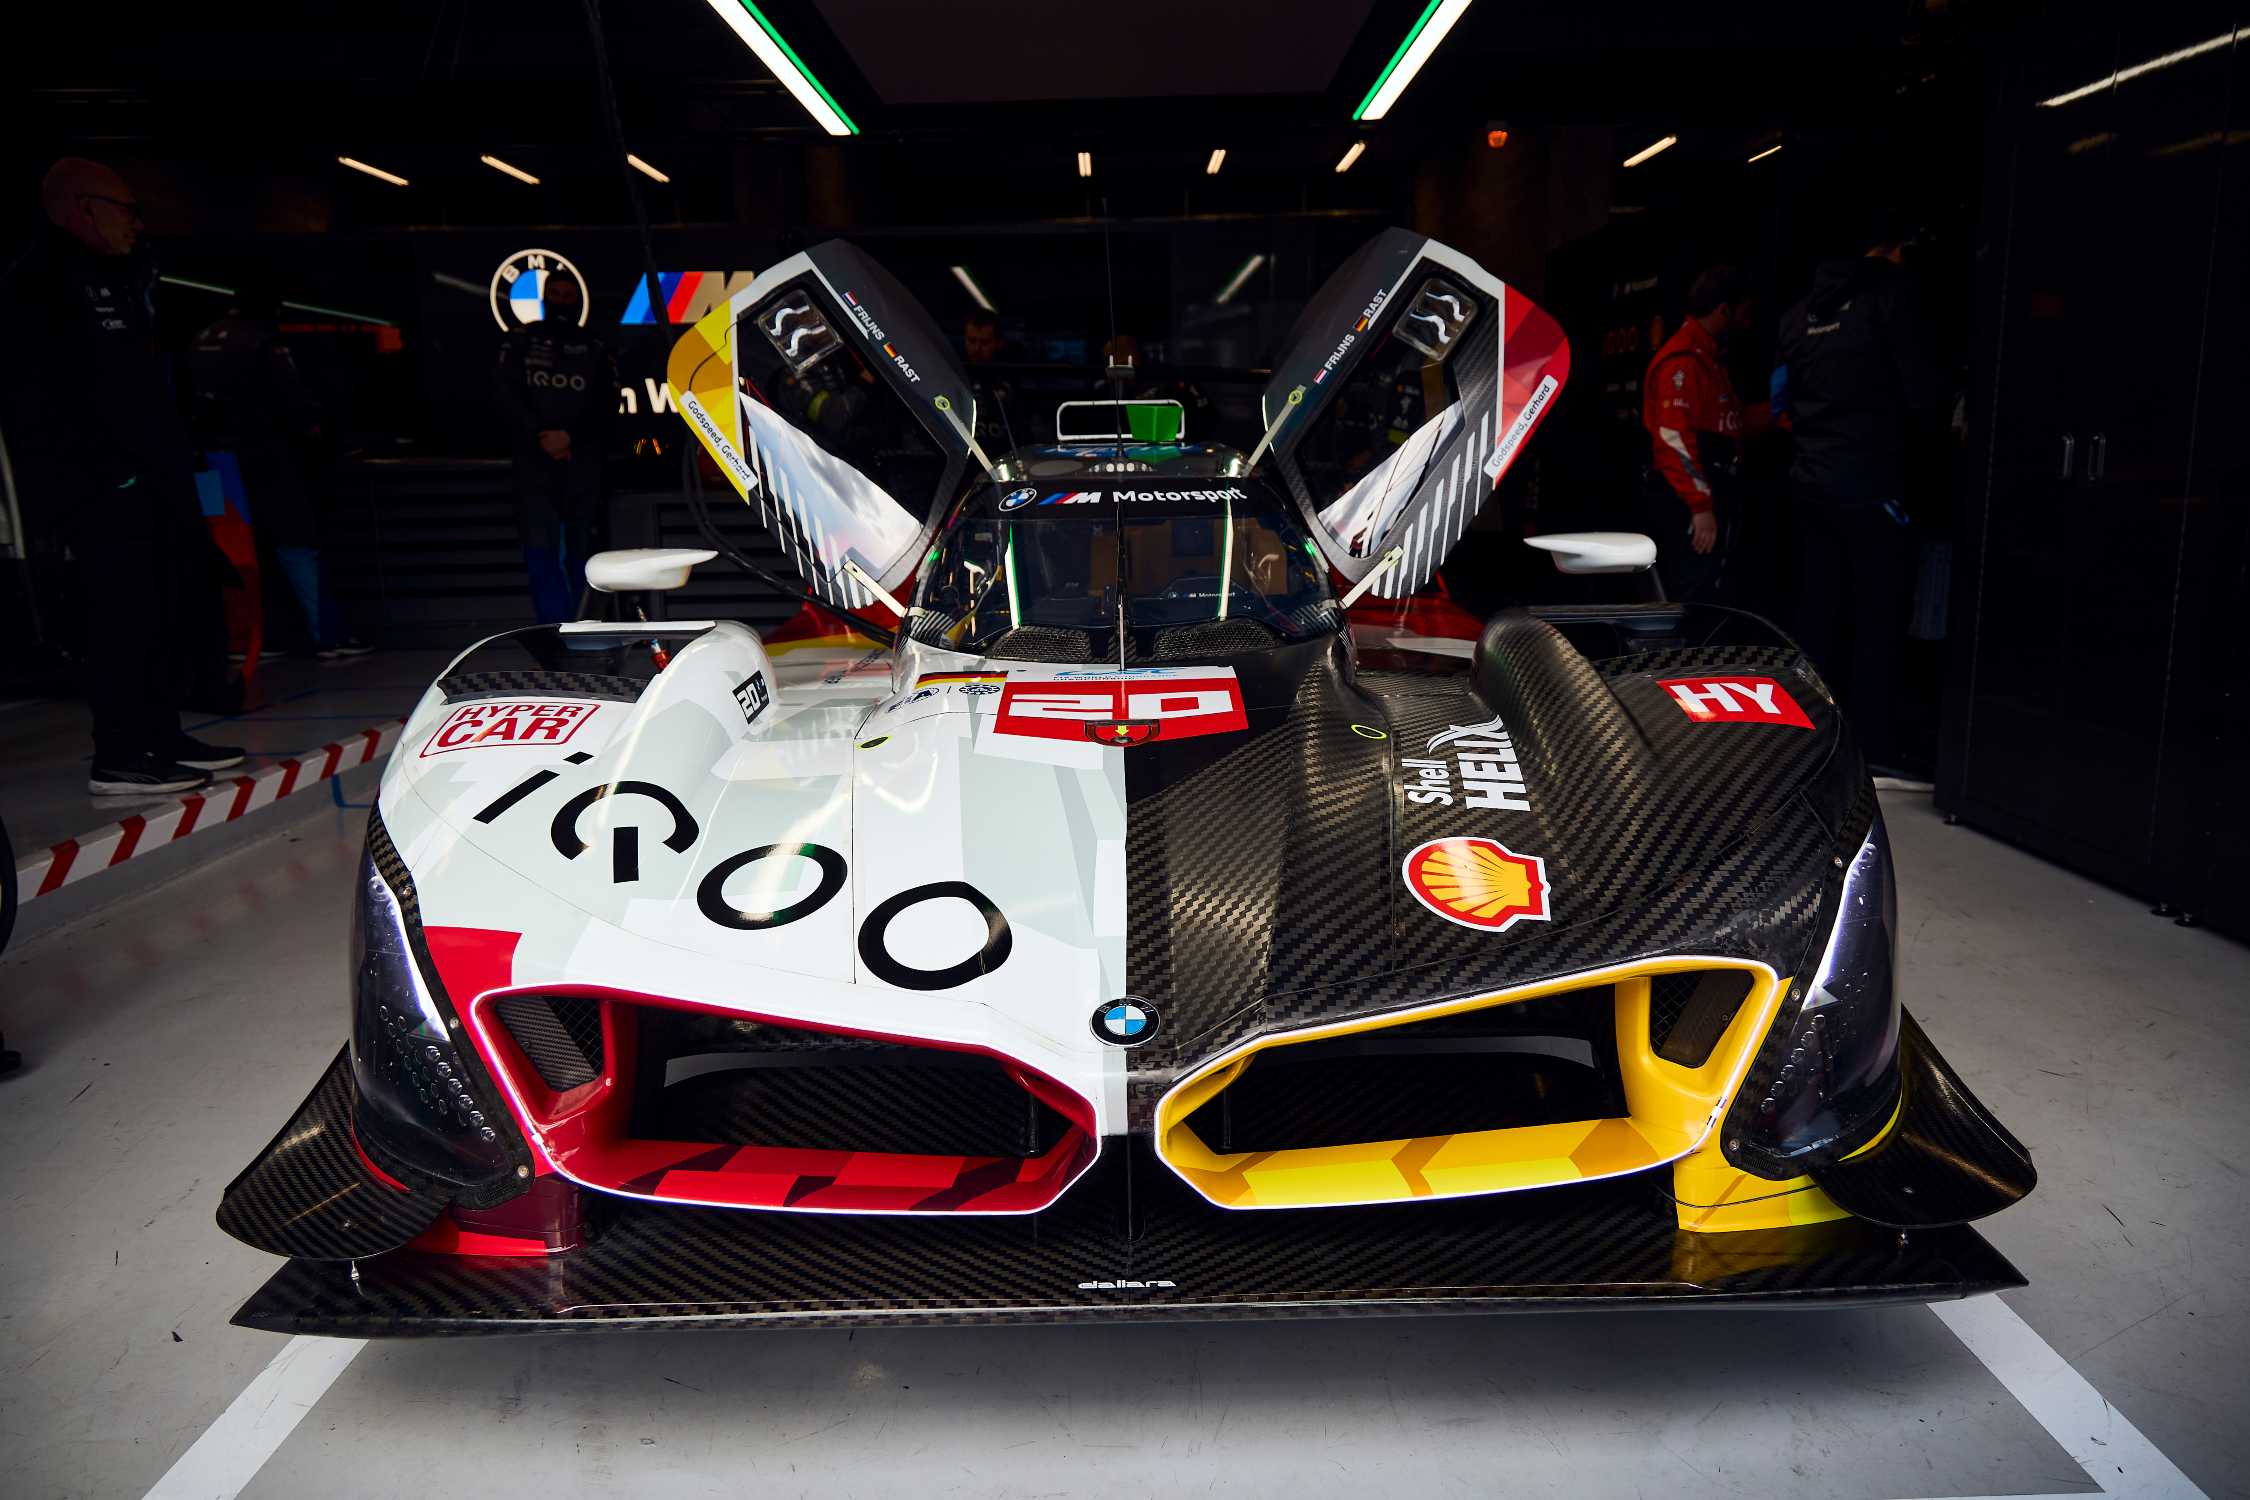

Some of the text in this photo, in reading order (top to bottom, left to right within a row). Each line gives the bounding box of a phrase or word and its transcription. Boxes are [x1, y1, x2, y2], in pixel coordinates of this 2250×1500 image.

[853, 305, 920, 382] FRIJNS RAST
[1324, 288, 1387, 370] FRIJNS RAST
[688, 400, 750, 481] Godspeed, Gerhard
[1491, 384, 1550, 468] Godspeed, Gerhard
[1112, 487, 1248, 503] Motorsport
[455, 704, 585, 722] HYPER
[736, 682, 761, 719] 20
[1007, 689, 1234, 721] 20
[1669, 681, 1782, 715] HY
[436, 716, 570, 748] CAR
[1401, 758, 1454, 806] Shell
[1426, 714, 1531, 812] HELIX
[472, 750, 1014, 991] iQOO
[1077, 1279, 1177, 1290] dallara
